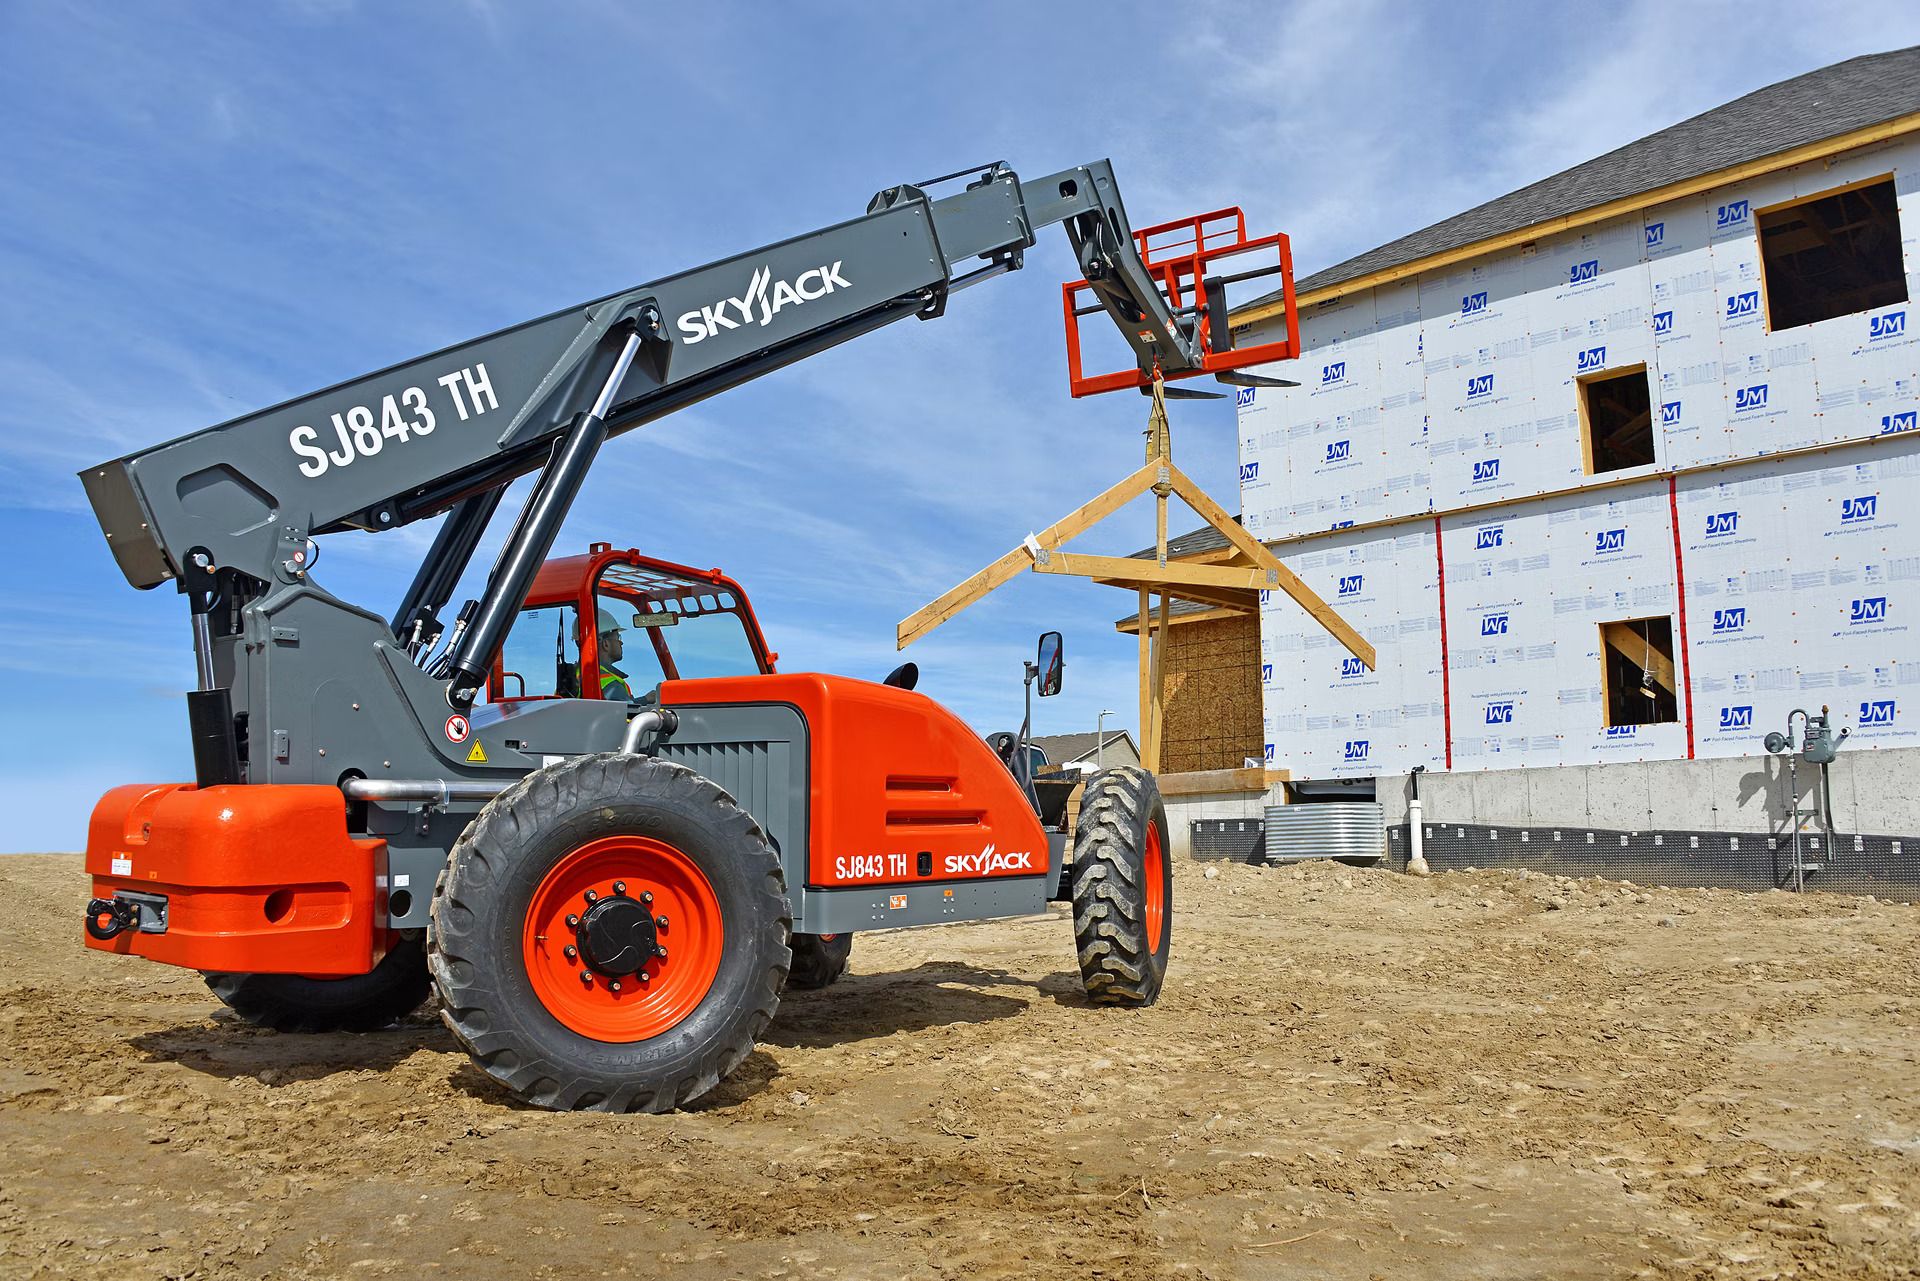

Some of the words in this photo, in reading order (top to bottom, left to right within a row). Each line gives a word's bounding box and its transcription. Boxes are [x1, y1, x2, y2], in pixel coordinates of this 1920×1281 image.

[1717, 200, 1748, 225] JM
[1570, 260, 1598, 283] JM
[677, 261, 852, 344] SKYJACK
[1462, 291, 1487, 313] JM
[1727, 291, 1758, 315] JM
[1870, 311, 1906, 337] JM
[1578, 346, 1606, 369] JM
[1322, 362, 1345, 382] JM
[1468, 374, 1493, 395] JM
[1736, 384, 1768, 408] JM
[290, 387, 435, 478] SJ843
[438, 363, 499, 420] TH
[1881, 411, 1917, 434] JM
[1326, 440, 1349, 460] JM
[1473, 459, 1499, 480] JM
[1842, 496, 1877, 519] JM
[1706, 512, 1738, 534] JM
[1477, 529, 1503, 549] JM
[1596, 529, 1625, 550] JM
[1339, 575, 1362, 593] JM
[1713, 608, 1745, 629] JM
[1851, 597, 1886, 620] JM
[1481, 616, 1508, 636] JM
[1342, 658, 1365, 675] JM
[1486, 705, 1513, 724] JM
[1720, 706, 1753, 727] JM
[1859, 701, 1895, 722] JM
[1344, 741, 1369, 758] JM
[836, 855, 883, 879] SJ843
[888, 854, 906, 876] TH
[945, 844, 1032, 874] SKYJACK
